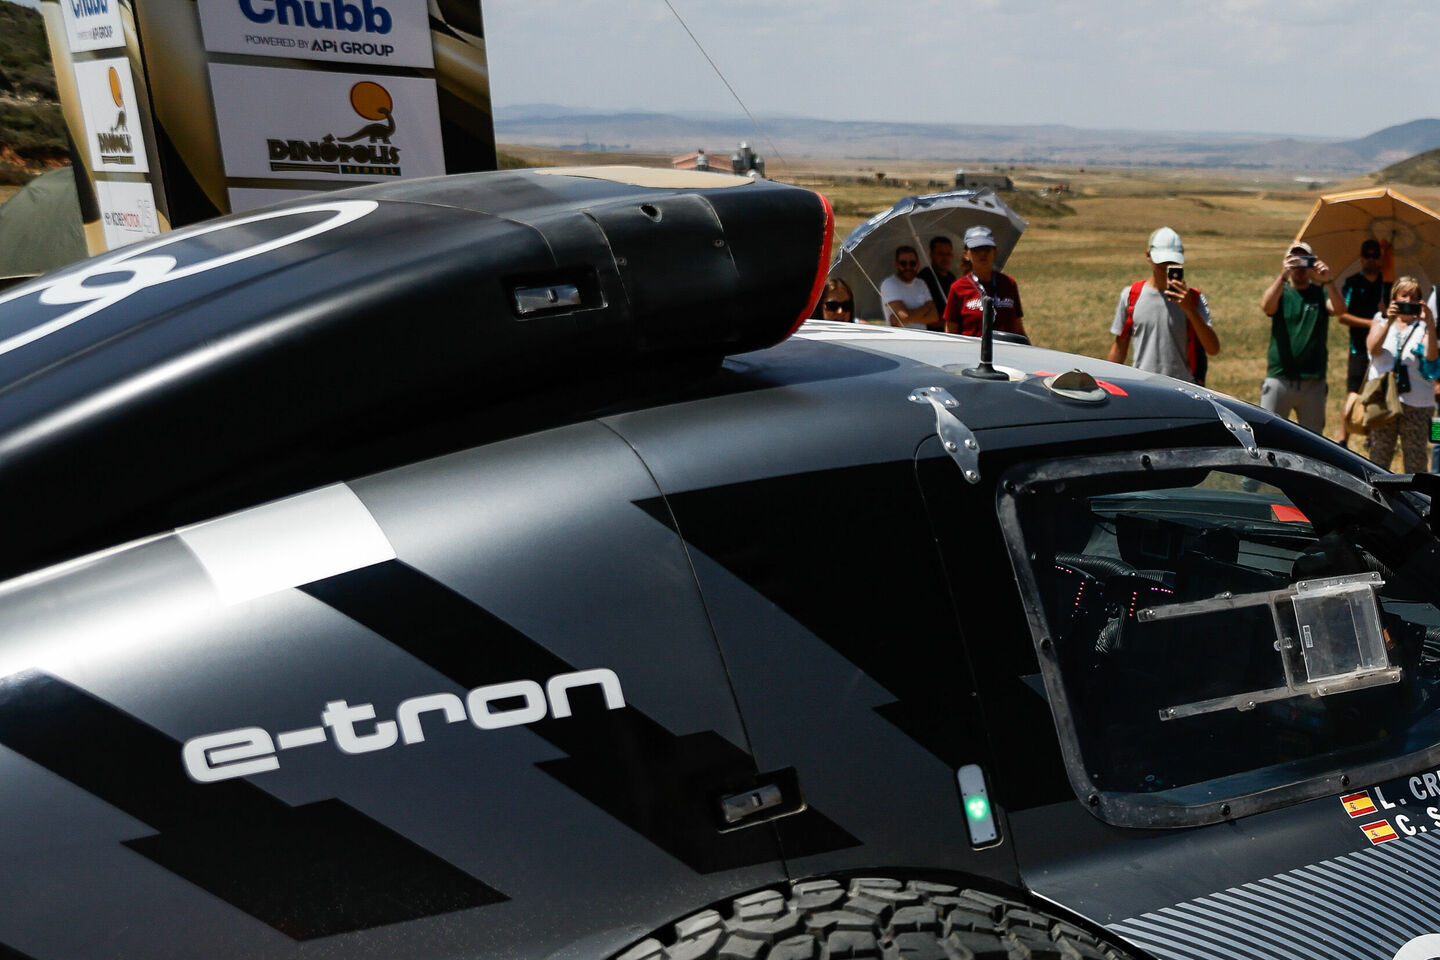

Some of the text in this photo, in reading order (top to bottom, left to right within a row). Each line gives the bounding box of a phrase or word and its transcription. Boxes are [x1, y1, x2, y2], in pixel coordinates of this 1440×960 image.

[239, 0, 393, 35] Chubb
[245, 34, 296, 48] POWERED
[298, 40, 310, 49] BY
[341, 41, 395, 56] GROUP
[266, 133, 401, 165] DINÓPOLIS
[182, 668, 627, 783] e-tron
[1394, 814, 1428, 836] C.
